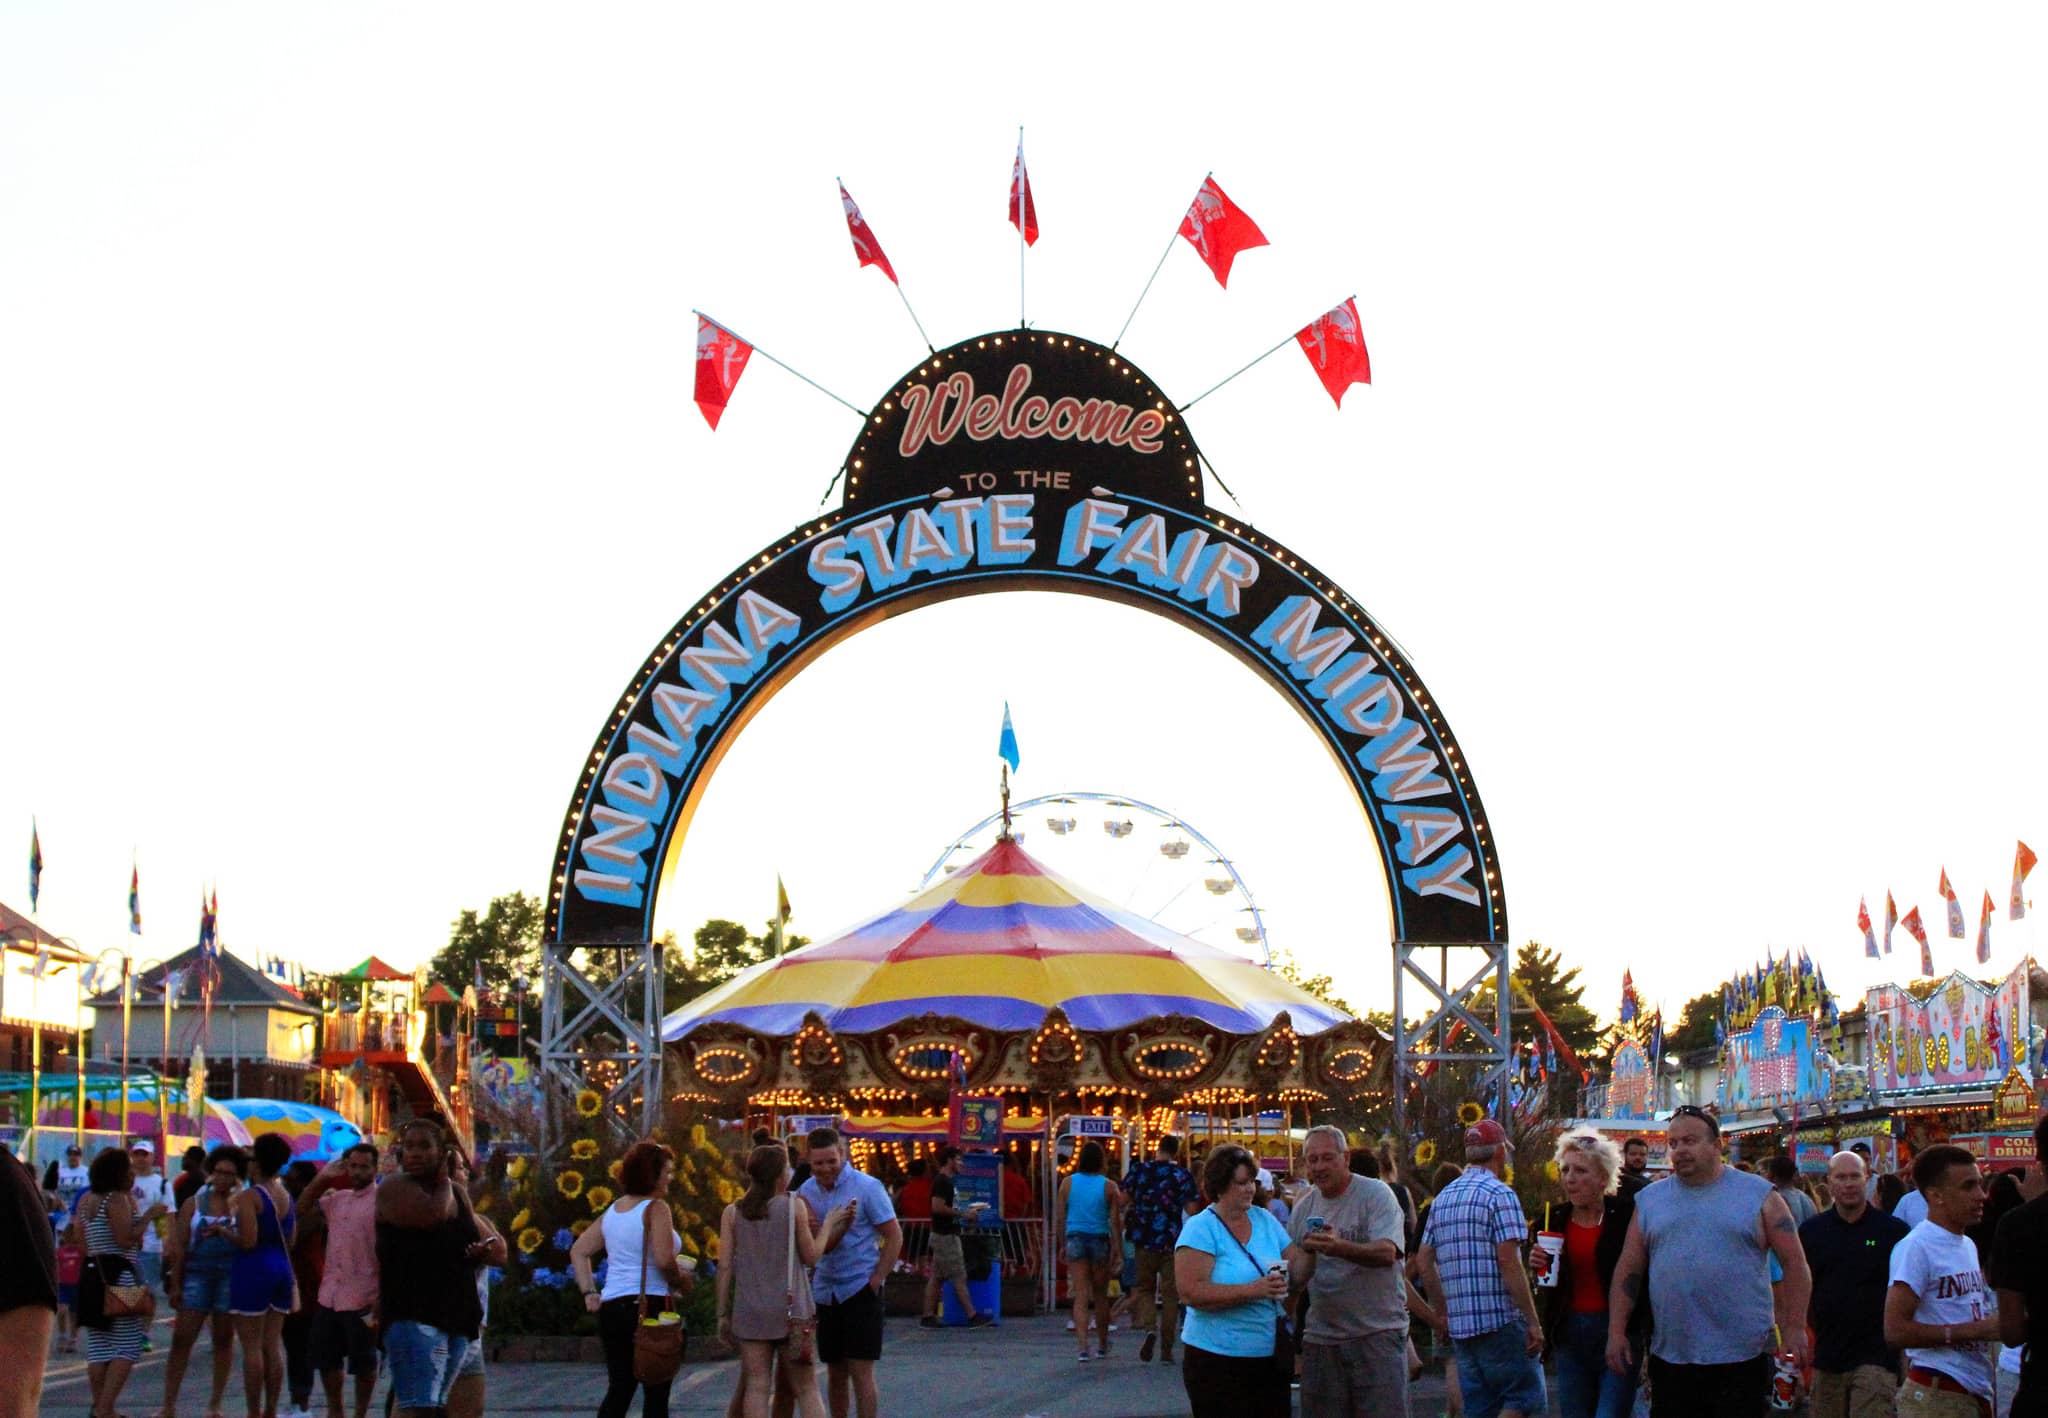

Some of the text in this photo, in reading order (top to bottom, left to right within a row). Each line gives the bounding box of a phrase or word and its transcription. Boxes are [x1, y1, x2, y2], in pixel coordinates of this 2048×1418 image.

[899, 363, 1165, 458] Welcome
[959, 470, 1071, 491] TO THE
[574, 494, 1482, 908] INDIANA STATE FAIR MIDWAY
[1084, 1121, 1107, 1132] EXIT
[2003, 1138, 2033, 1147] COL
[1995, 1147, 2037, 1156] DRIN
